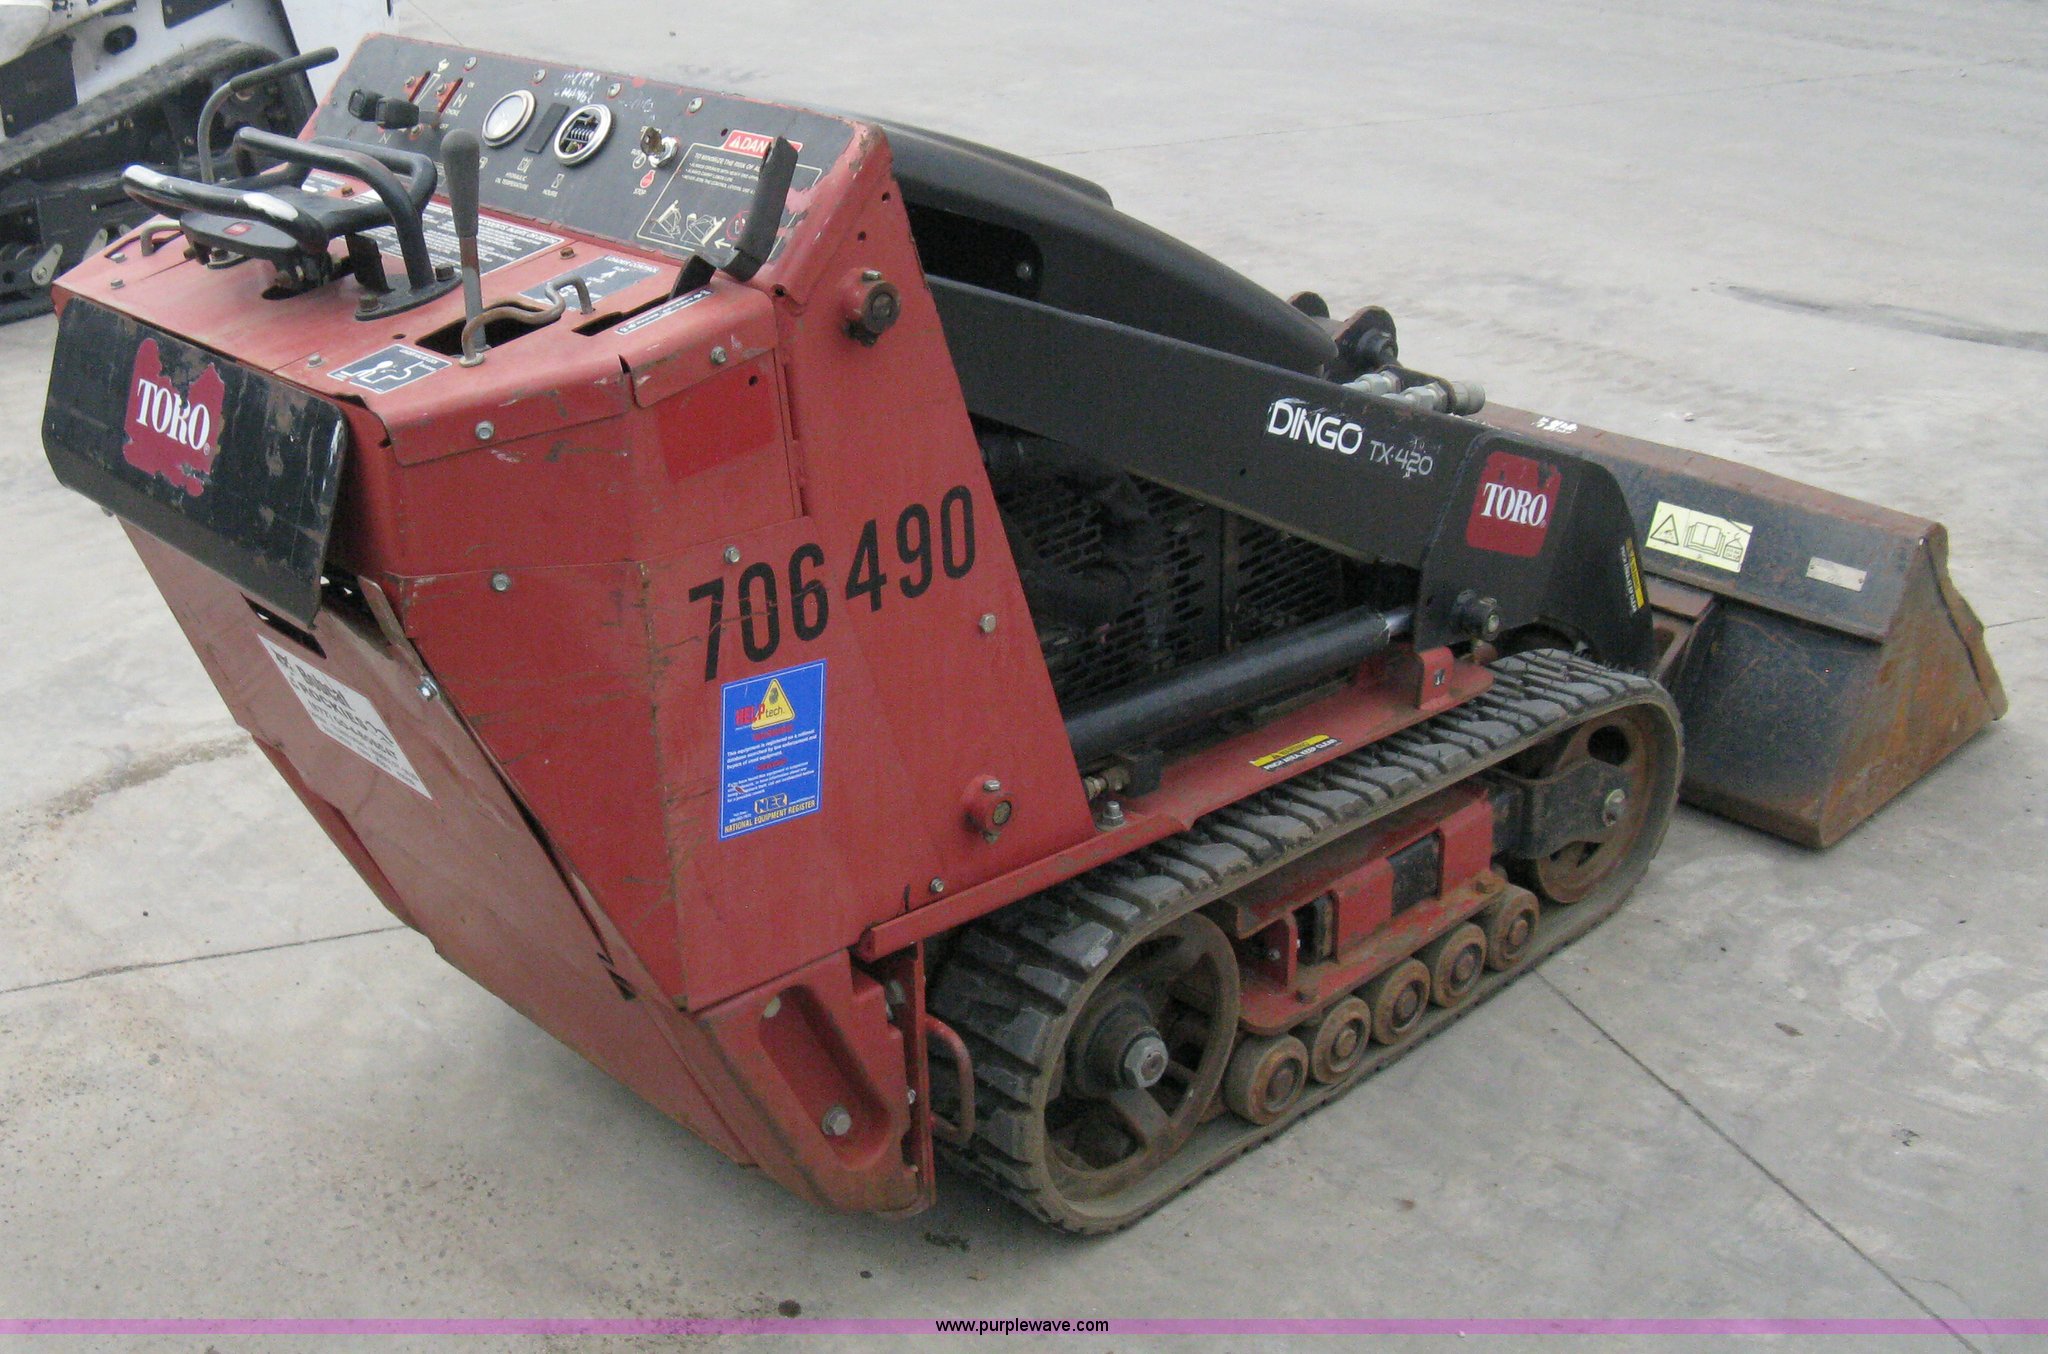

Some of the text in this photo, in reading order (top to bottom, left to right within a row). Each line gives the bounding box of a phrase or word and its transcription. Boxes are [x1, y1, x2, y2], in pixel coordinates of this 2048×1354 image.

[740, 137, 770, 153] DAN
[136, 378, 210, 450] TORO
[1267, 399, 1363, 454] DINGO
[1481, 482, 1548, 526] TORO
[724, 817, 752, 833] NATIONAL
[754, 807, 786, 824] EQUIPMENT
[788, 799, 815, 814] REGISTER
